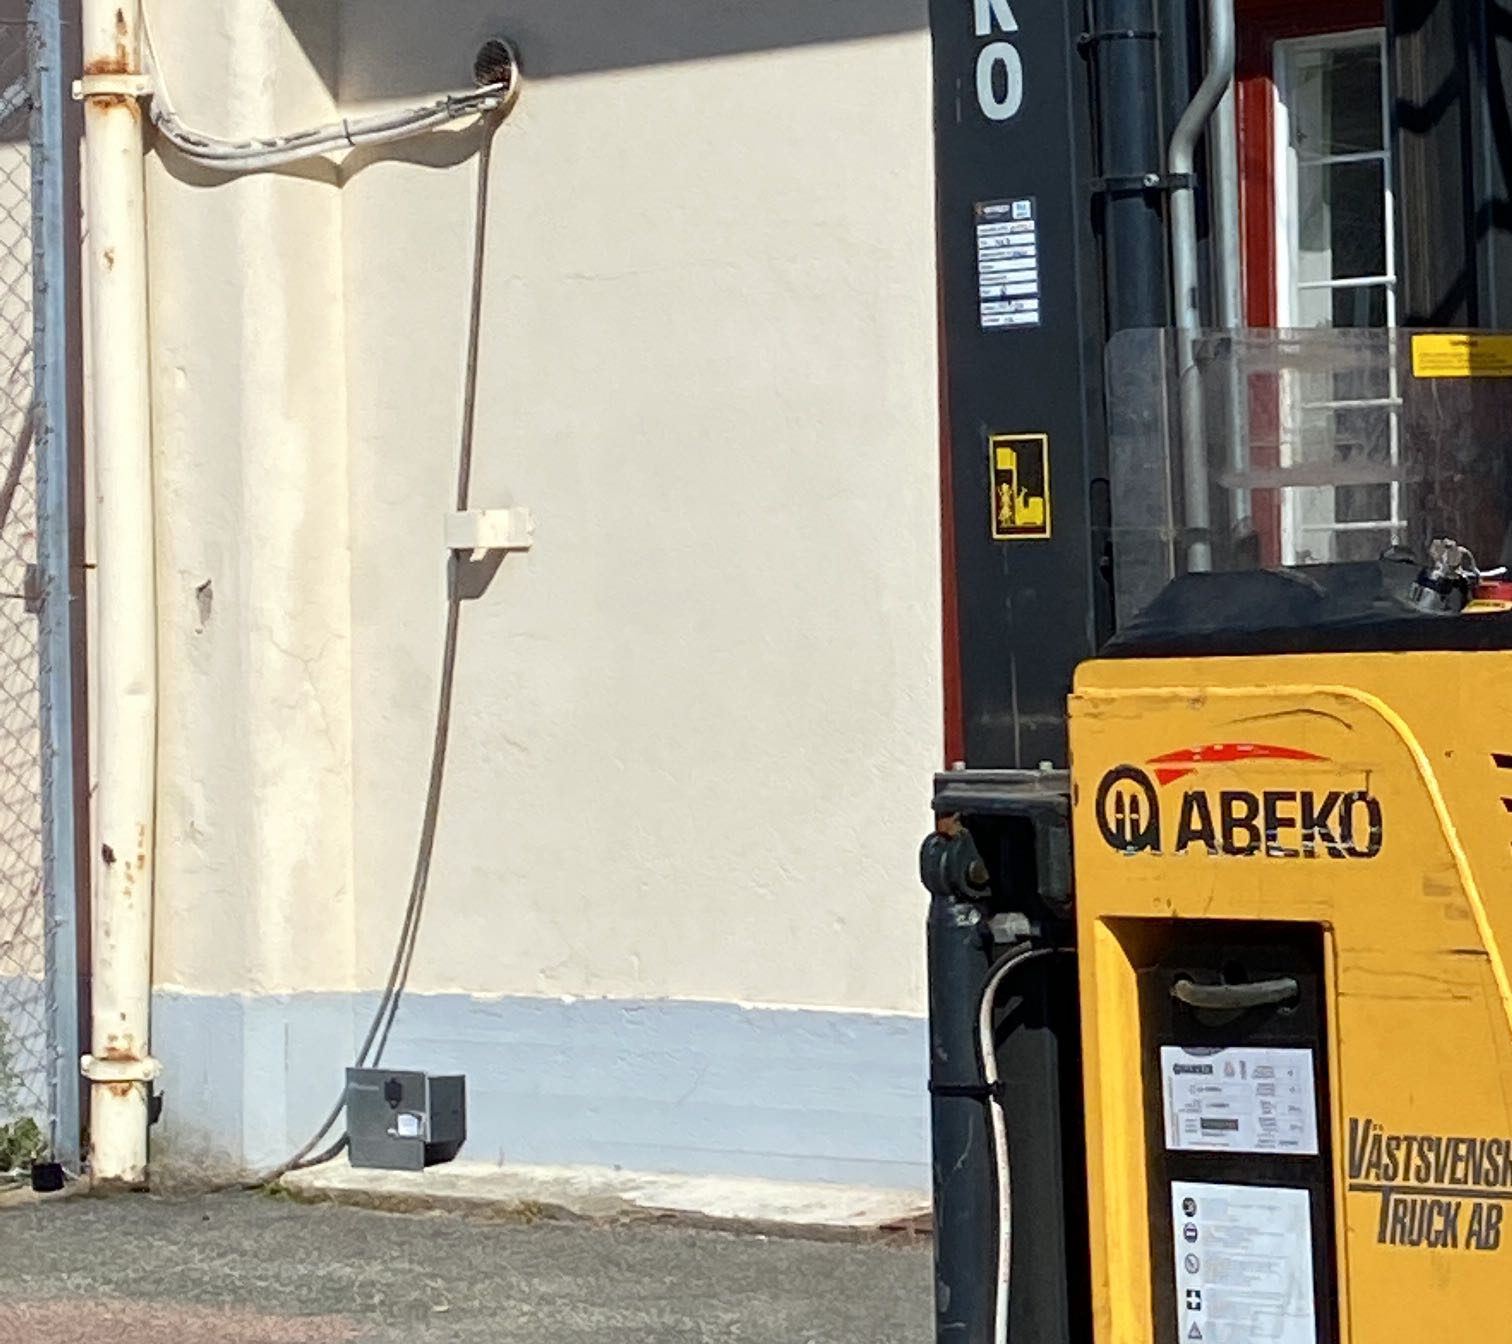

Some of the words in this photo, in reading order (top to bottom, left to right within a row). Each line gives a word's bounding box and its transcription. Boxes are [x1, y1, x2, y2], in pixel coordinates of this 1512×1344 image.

[1174, 788, 1384, 859] ABEKO
[1377, 1186, 1462, 1249] TRUCK
[1465, 1202, 1504, 1251] AB
